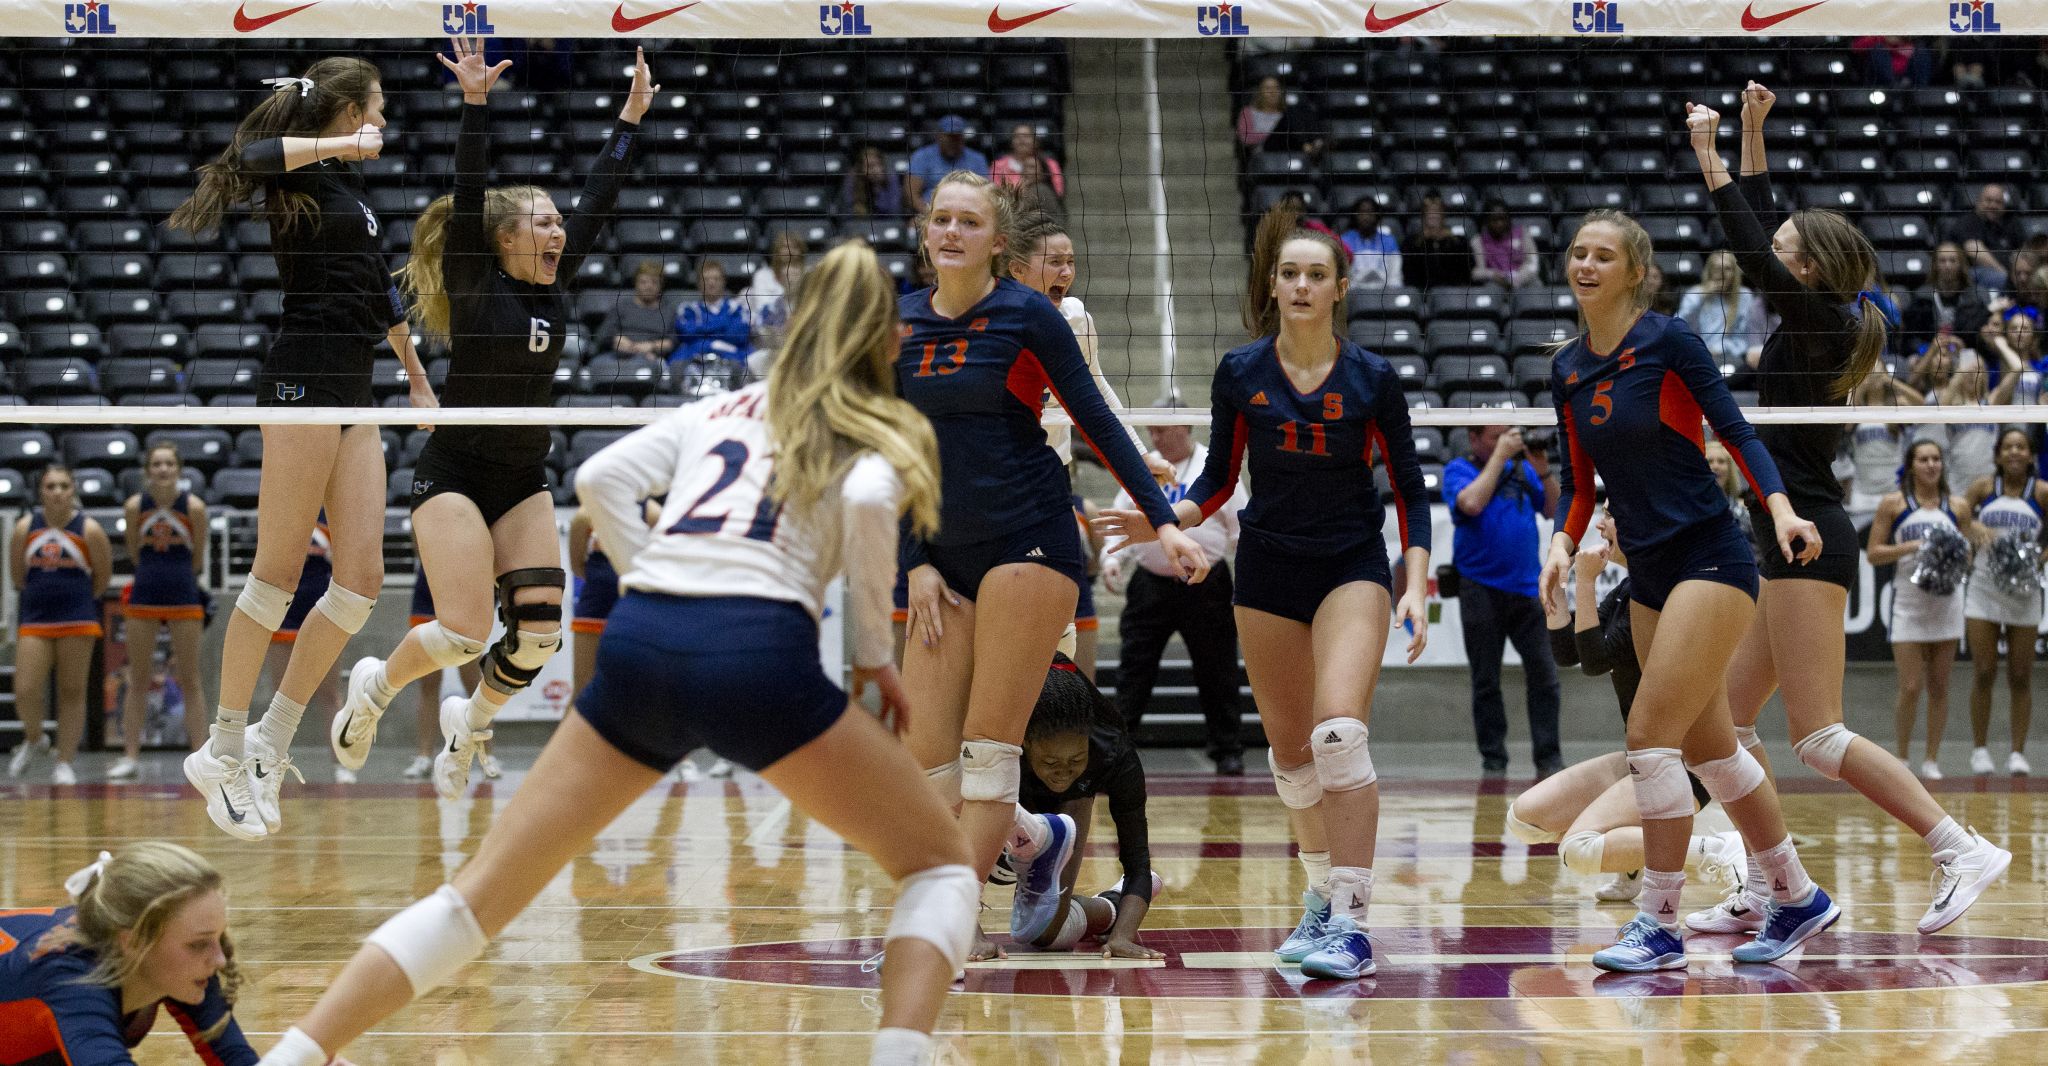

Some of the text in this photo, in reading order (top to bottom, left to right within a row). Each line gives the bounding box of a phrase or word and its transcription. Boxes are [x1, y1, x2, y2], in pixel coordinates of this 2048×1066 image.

[65, 0, 117, 34] UIL
[443, 0, 495, 35] UIL
[820, 0, 872, 35] UIL
[1197, 1, 1249, 35] UIL
[1573, 0, 1624, 33] UIL
[1949, 0, 2001, 33] UIL
[528, 316, 551, 353] 6
[912, 337, 969, 377] 13
[1322, 392, 1344, 420] S
[1590, 379, 1615, 426] 5
[1275, 419, 1332, 457] 11
